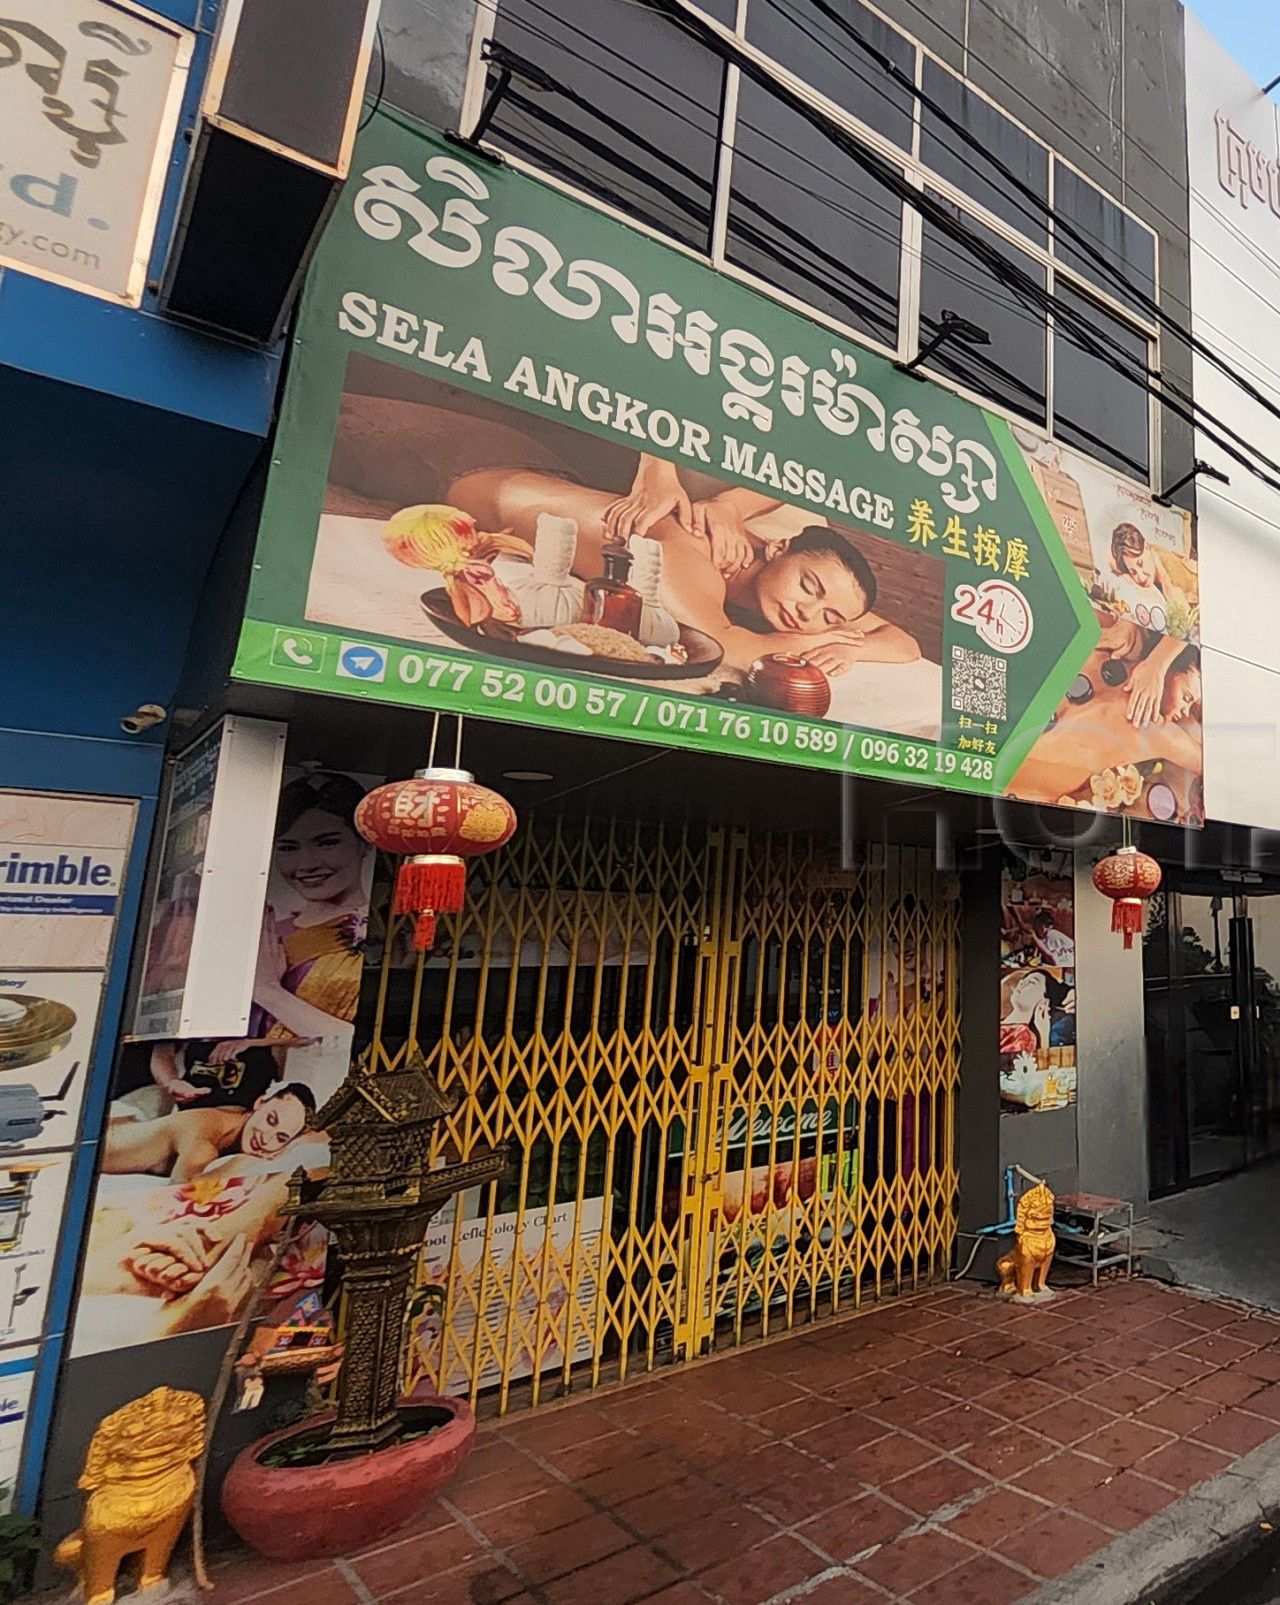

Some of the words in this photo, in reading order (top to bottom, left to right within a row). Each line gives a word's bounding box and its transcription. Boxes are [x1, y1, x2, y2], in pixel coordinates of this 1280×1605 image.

[338, 292, 492, 383] SELA
[504, 356, 712, 463] ANGKOR
[720, 435, 895, 530] MASSAGE
[905, 498, 1031, 582] 养生按摩
[398, 654, 474, 692] 077
[480, 669, 526, 703] 52
[534, 678, 577, 710] 00
[584, 688, 628, 718] 57
[631, 696, 650, 726] /
[656, 700, 709, 733] 071
[717, 711, 751, 740] 76
[759, 718, 790, 746] 10
[794, 725, 838, 753] 589
[842, 734, 855, 761] /
[860, 737, 900, 766] 096
[903, 745, 929, 770] 32
[934, 751, 957, 775] 19
[959, 756, 994, 781] 428
[957, 714, 998, 735] 扫一扫
[957, 735, 997, 756] 加好友
[716, 1108, 833, 1142] Welcome
